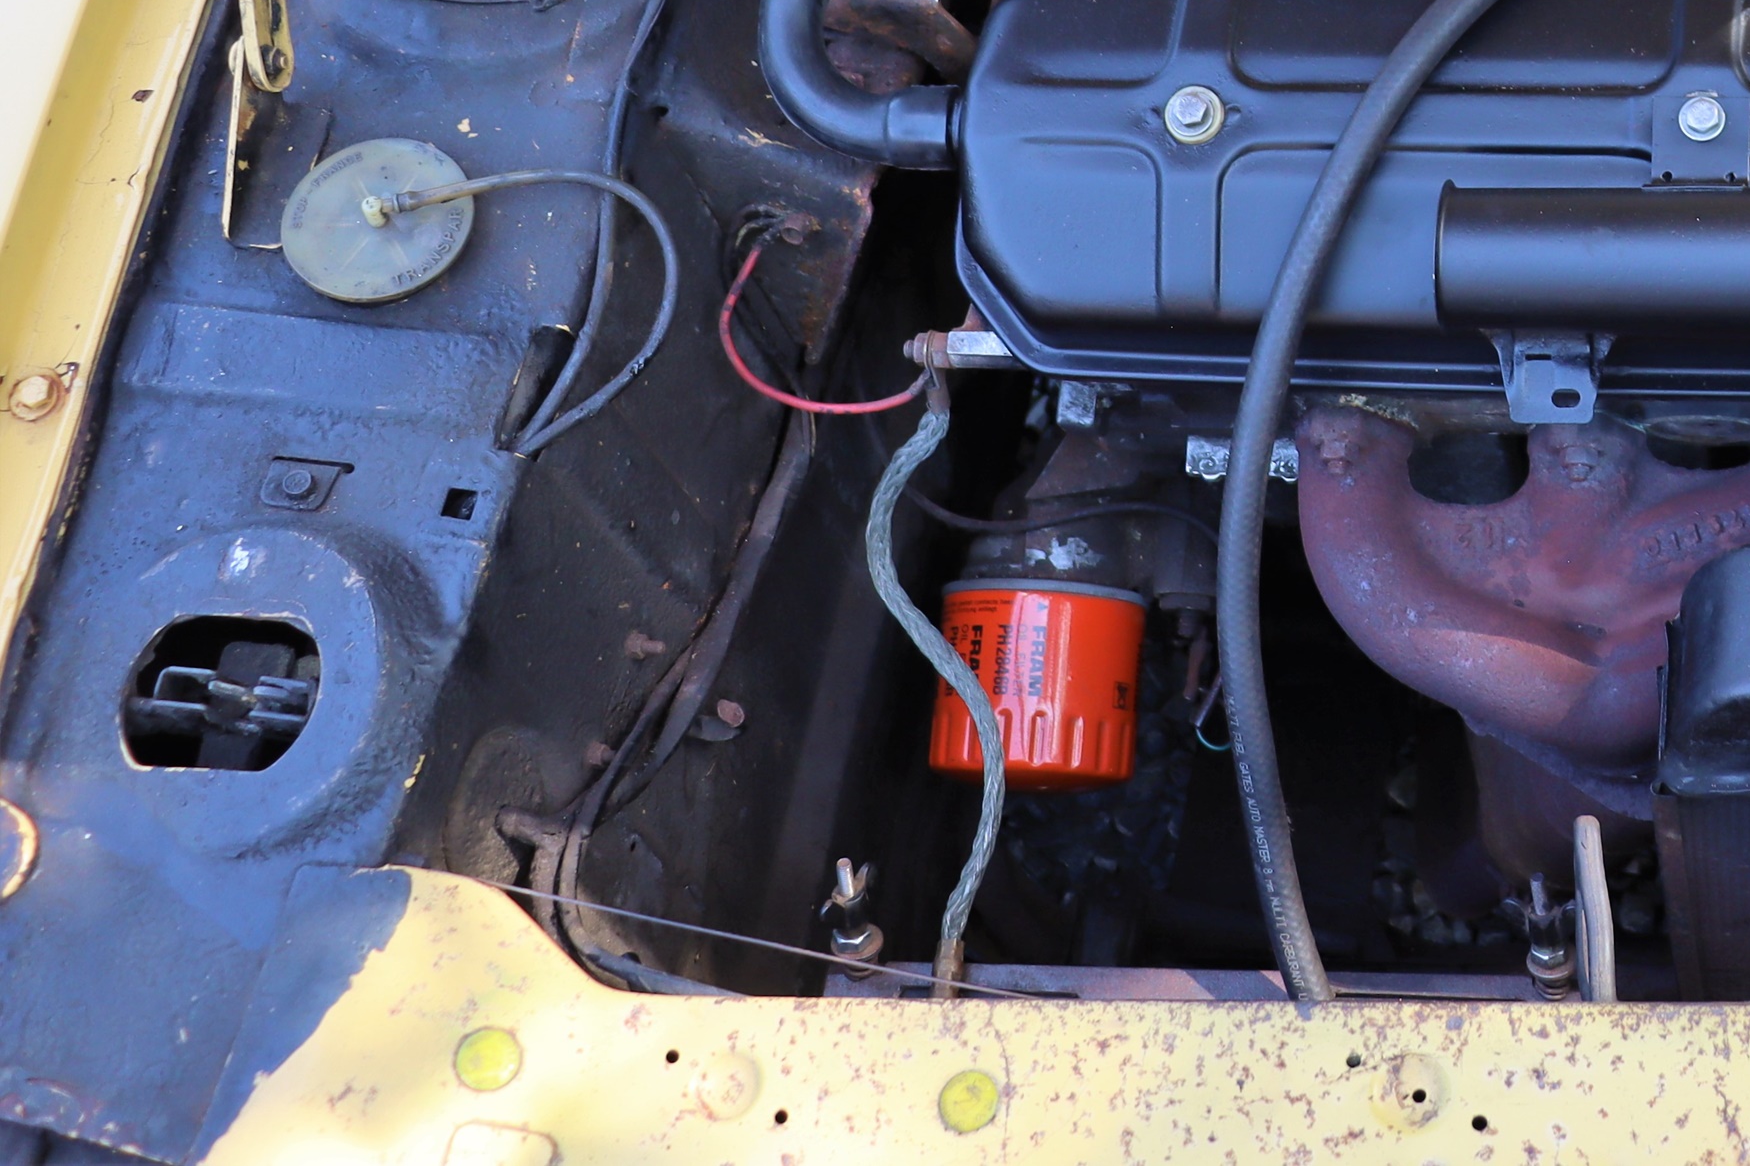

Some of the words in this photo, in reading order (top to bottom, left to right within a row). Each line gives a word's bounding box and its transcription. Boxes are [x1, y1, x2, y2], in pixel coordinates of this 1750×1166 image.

[391, 206, 466, 286] TRANSPAR
[969, 623, 984, 678] FRA
[1012, 652, 1027, 697] FILTER
[1027, 624, 1048, 697] FRAM
